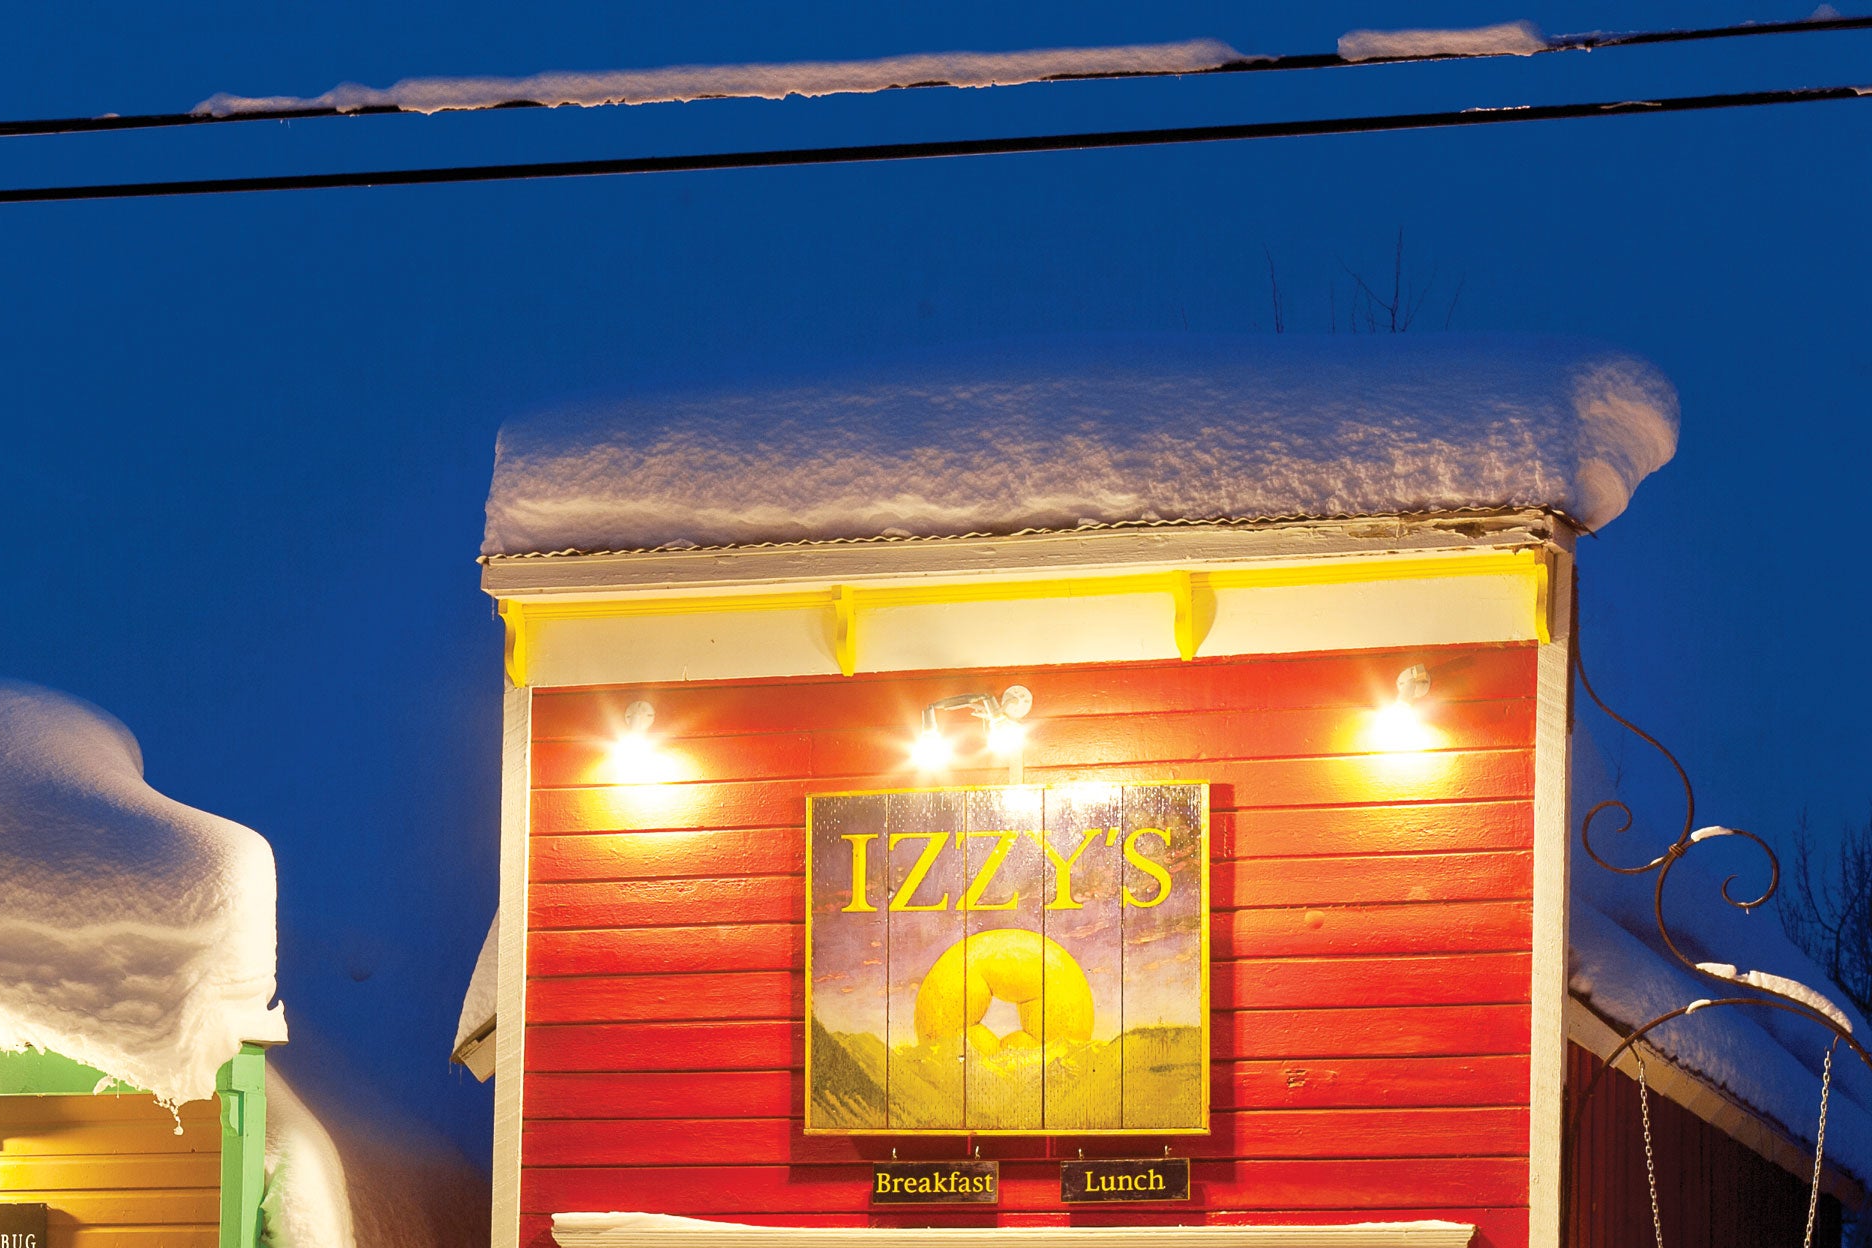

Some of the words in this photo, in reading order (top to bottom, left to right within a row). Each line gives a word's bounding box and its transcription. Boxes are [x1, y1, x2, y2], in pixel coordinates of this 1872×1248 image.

[840, 826, 1173, 914] IZZY'S
[876, 1172, 994, 1194] Breakfast
[1084, 1170, 1166, 1193] Lunch
